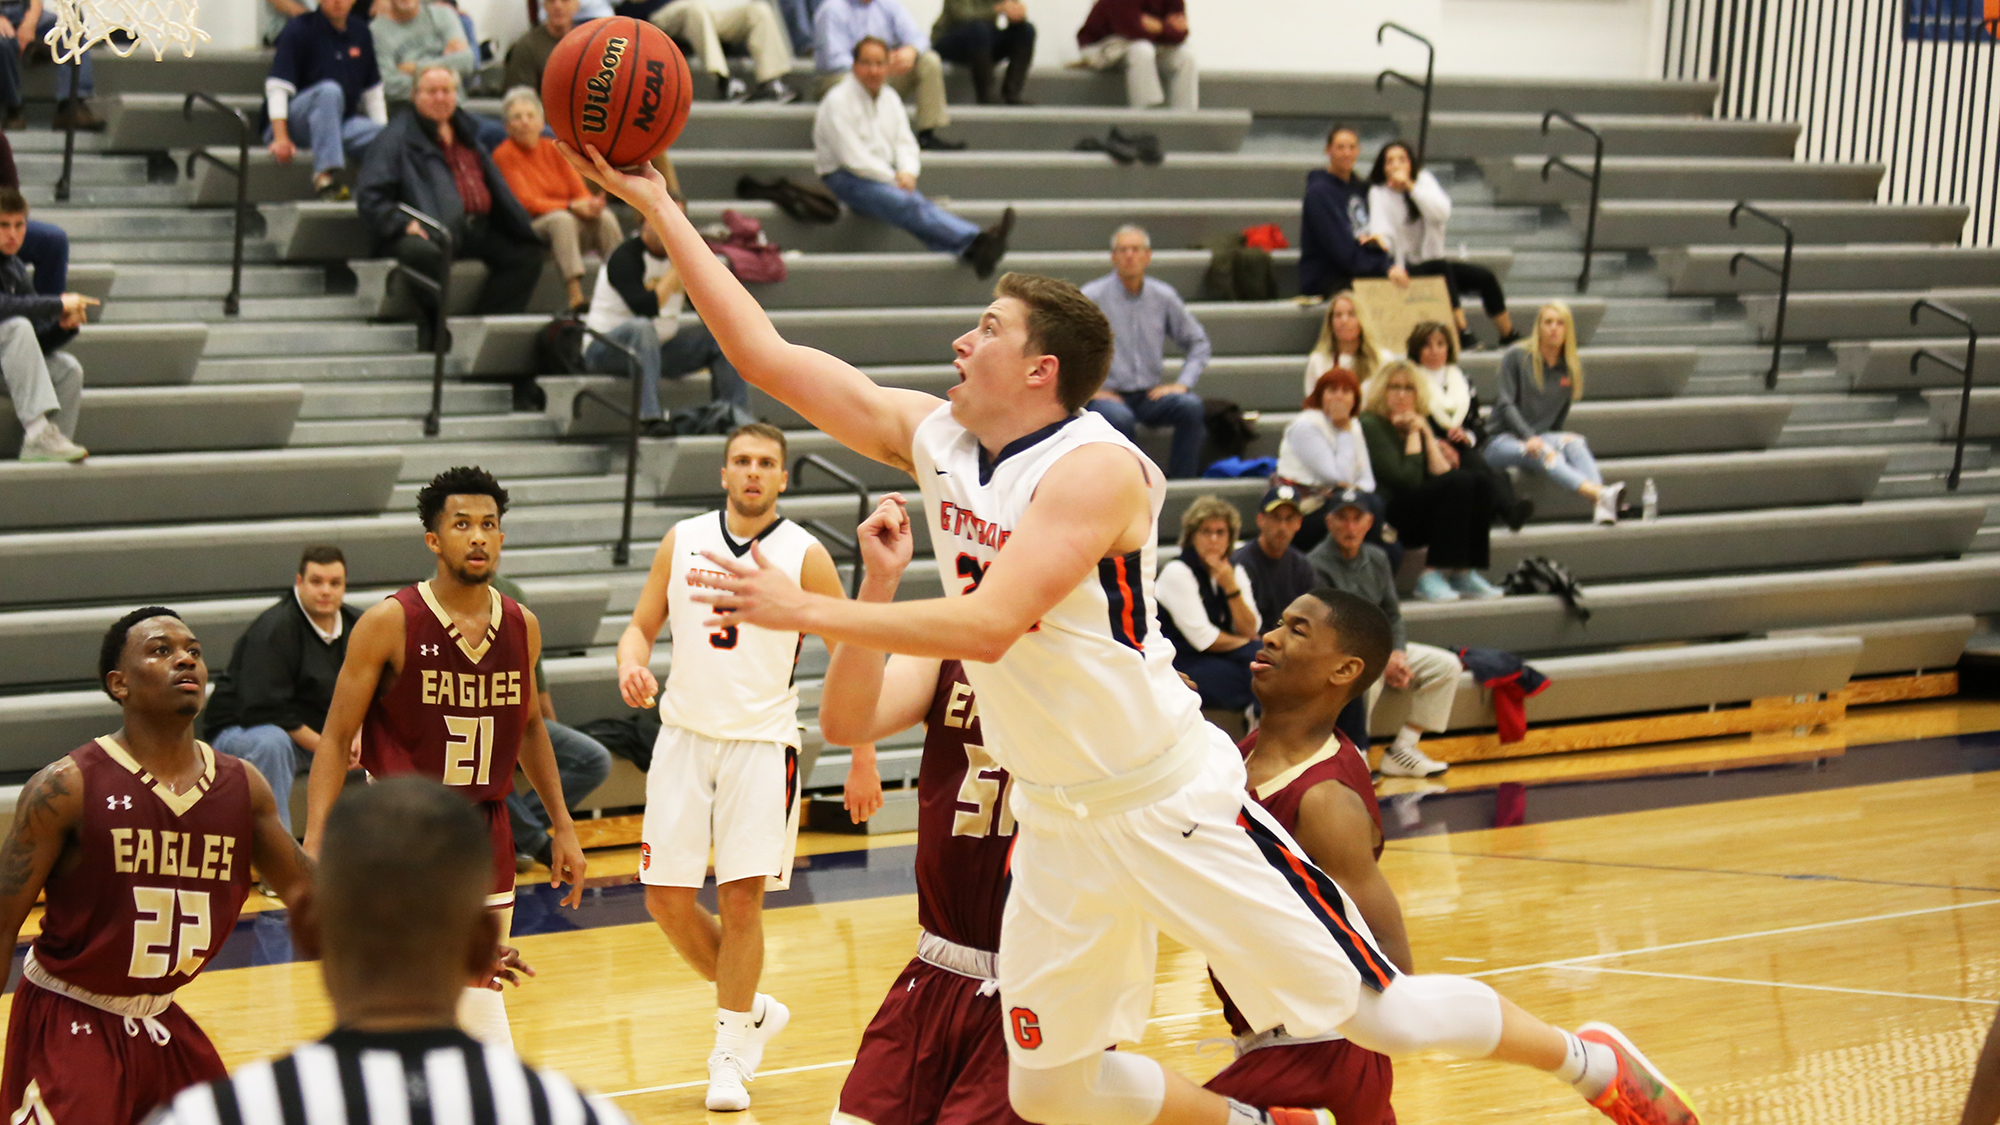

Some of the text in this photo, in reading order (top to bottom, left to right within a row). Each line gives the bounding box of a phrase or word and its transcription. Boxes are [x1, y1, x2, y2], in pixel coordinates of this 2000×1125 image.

[582, 36, 629, 134] Wilson
[633, 60, 664, 132] NCAA
[421, 670, 521, 708] EAGLES
[443, 715, 495, 786] 21
[111, 828, 236, 881] EAGLES
[128, 886, 212, 979] 22
[1010, 1007, 1043, 1050] G
